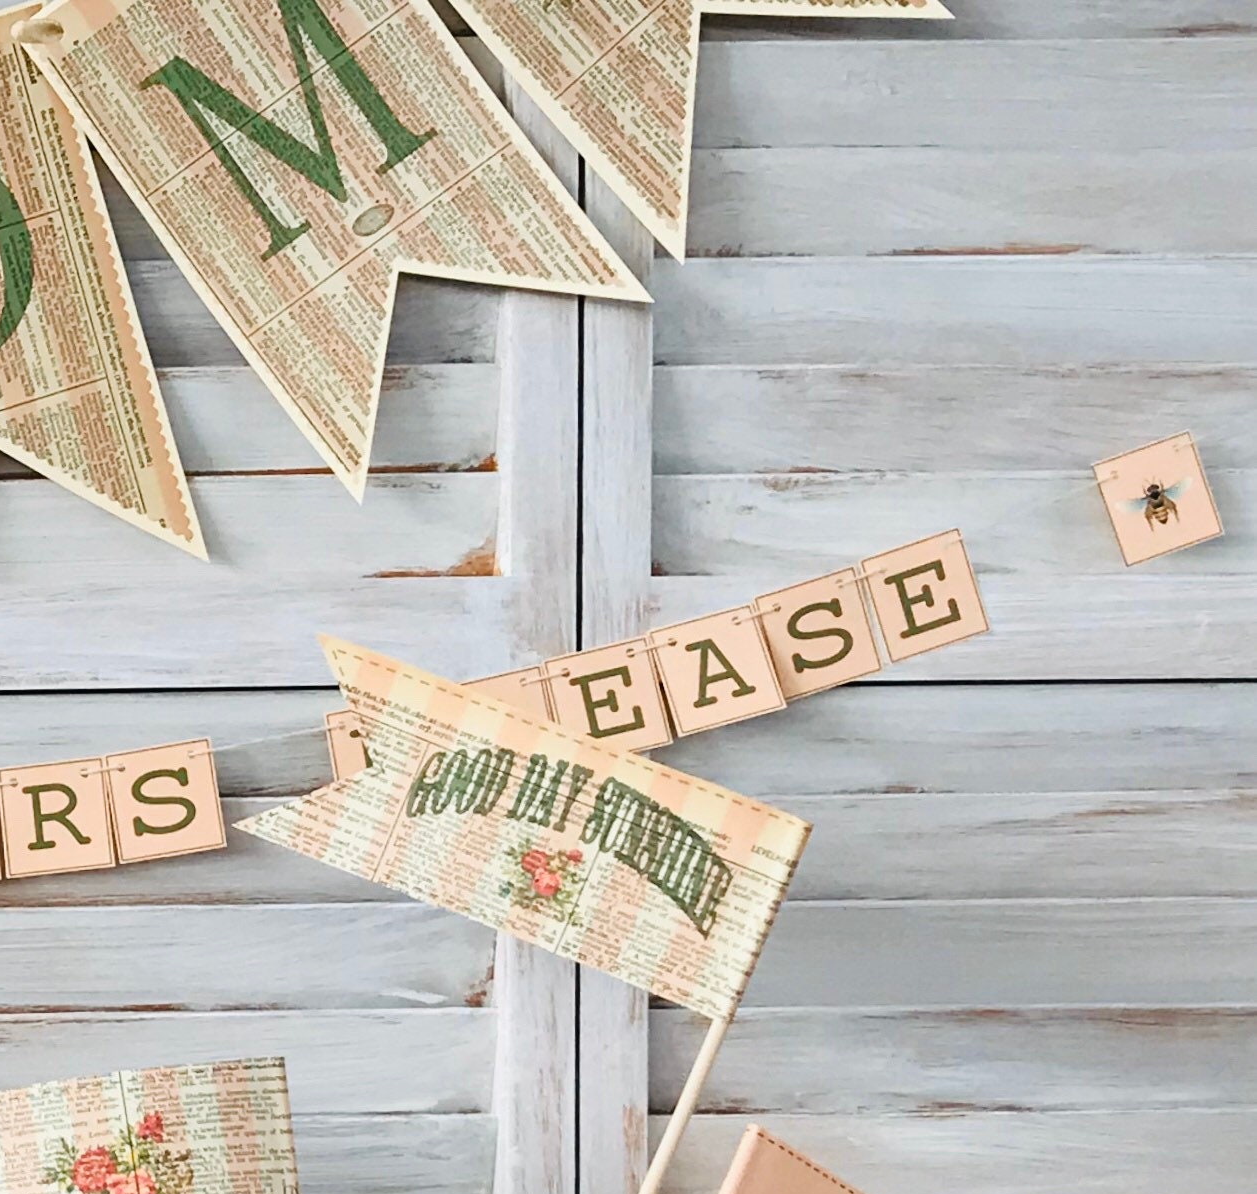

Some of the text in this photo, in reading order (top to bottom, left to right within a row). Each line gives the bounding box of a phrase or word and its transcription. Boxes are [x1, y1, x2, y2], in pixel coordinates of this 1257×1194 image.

[573, 559, 962, 740] EASE
[406, 748, 734, 940] GOOD DAY SUNSHINE
